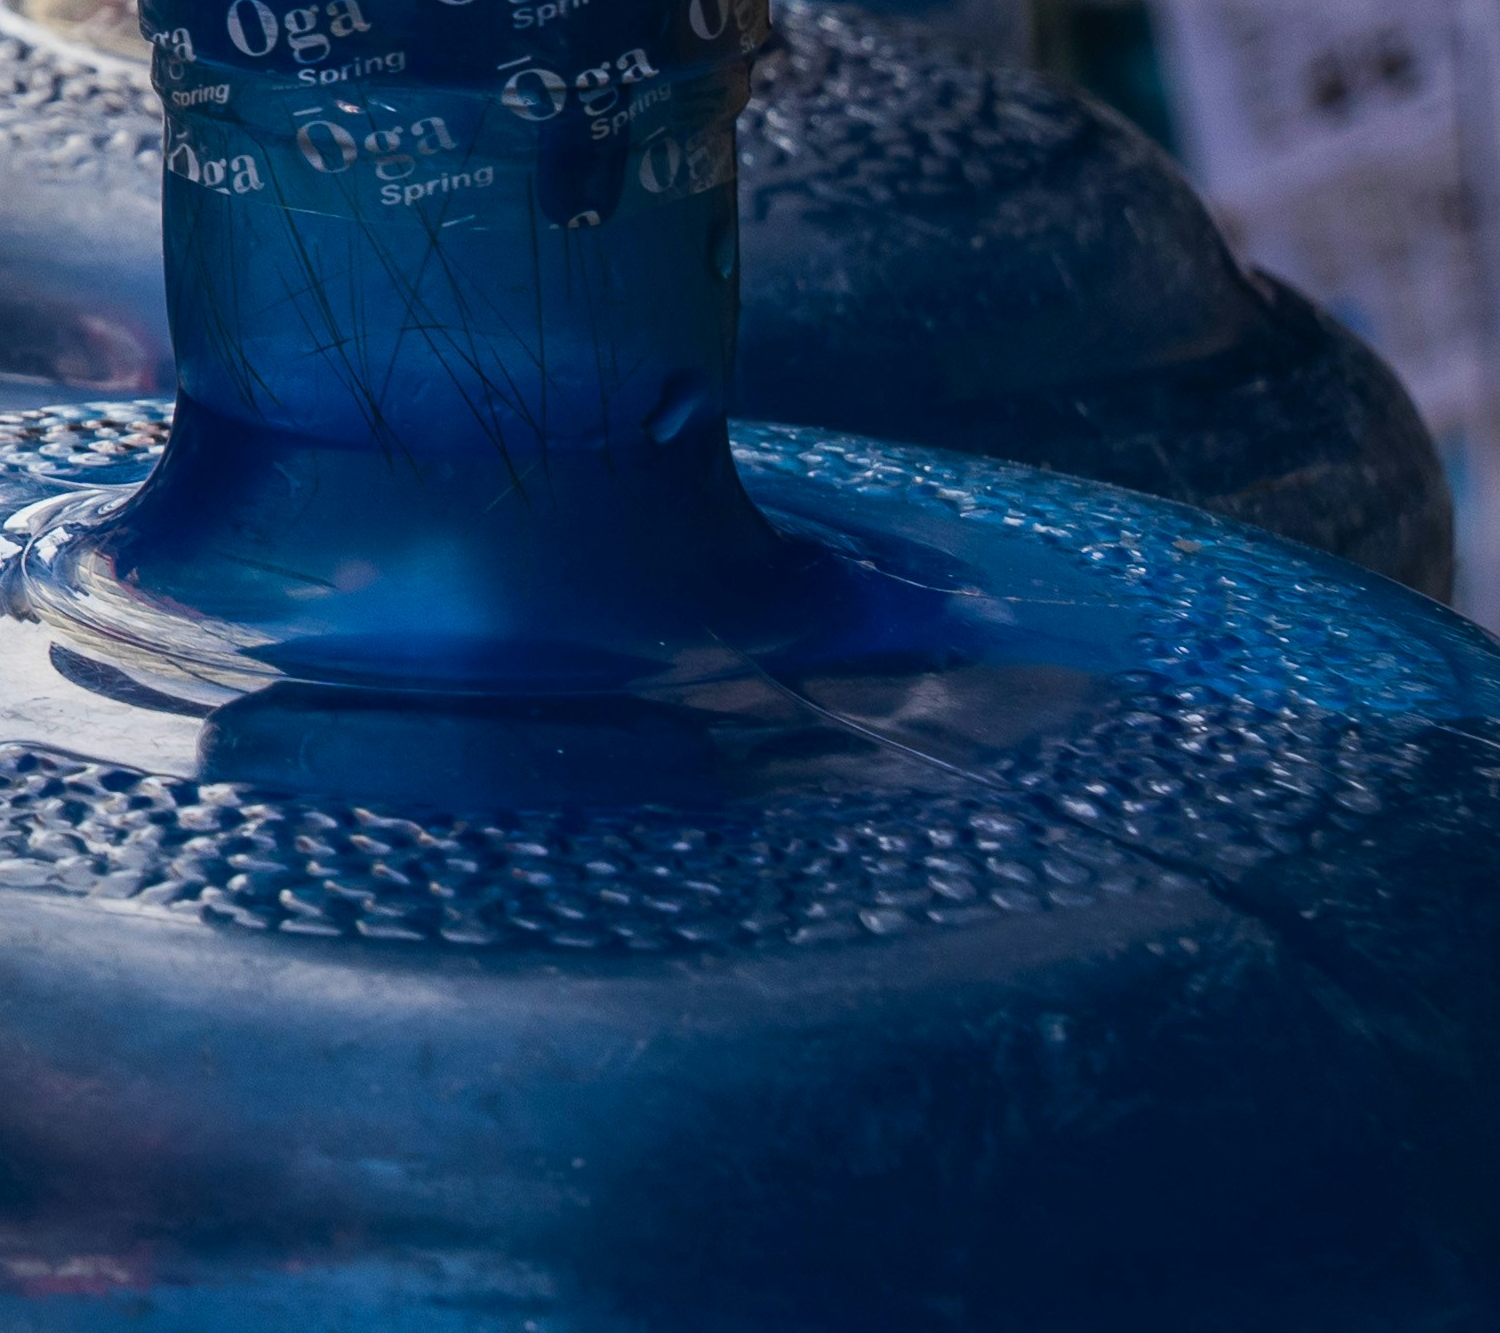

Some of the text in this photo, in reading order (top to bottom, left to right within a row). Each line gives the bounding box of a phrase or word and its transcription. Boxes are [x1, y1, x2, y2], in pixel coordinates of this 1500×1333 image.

[298, 50, 406, 87] Spring
[590, 83, 673, 141] Spring
[380, 165, 494, 206] Spring
